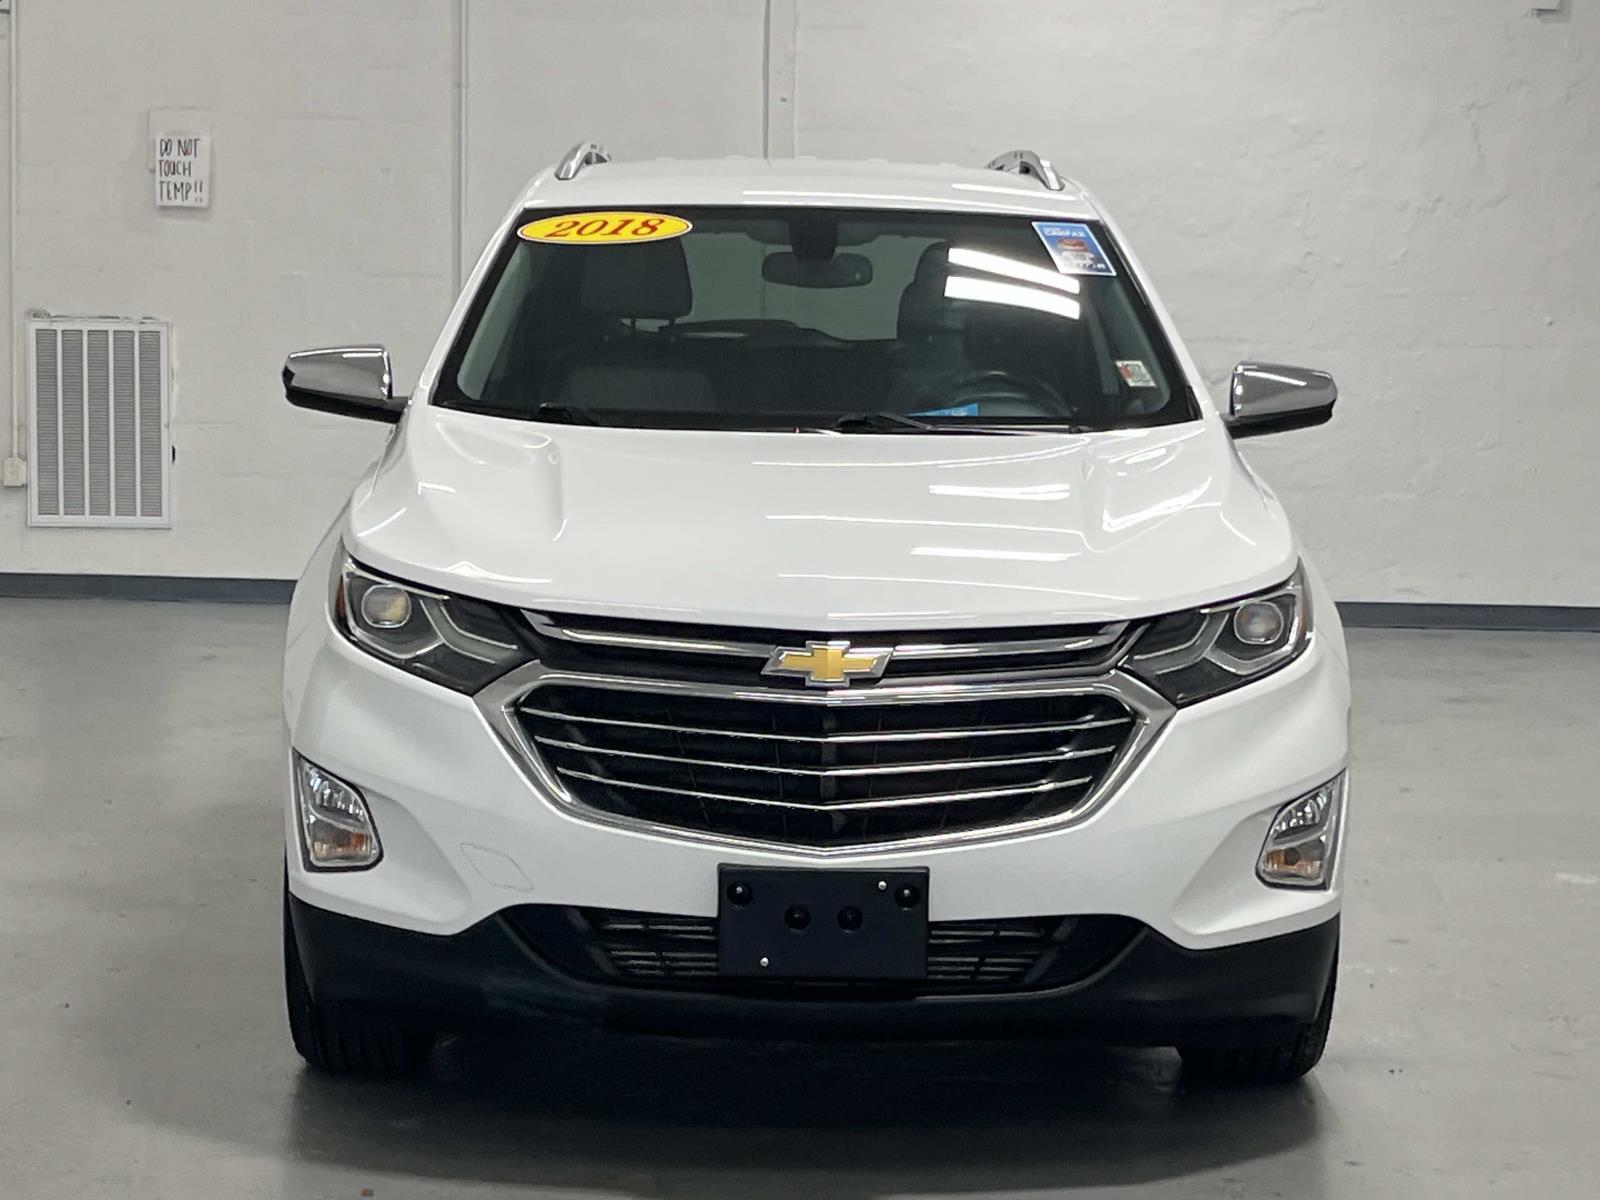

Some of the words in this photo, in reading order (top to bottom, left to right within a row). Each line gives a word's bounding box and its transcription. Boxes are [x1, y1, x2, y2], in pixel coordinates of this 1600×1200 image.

[160, 138, 173, 158] DO
[177, 138, 202, 158] NOT
[159, 159, 192, 177] TOUCH
[159, 180, 203, 202] TEMP!!
[544, 218, 665, 238] 2018
